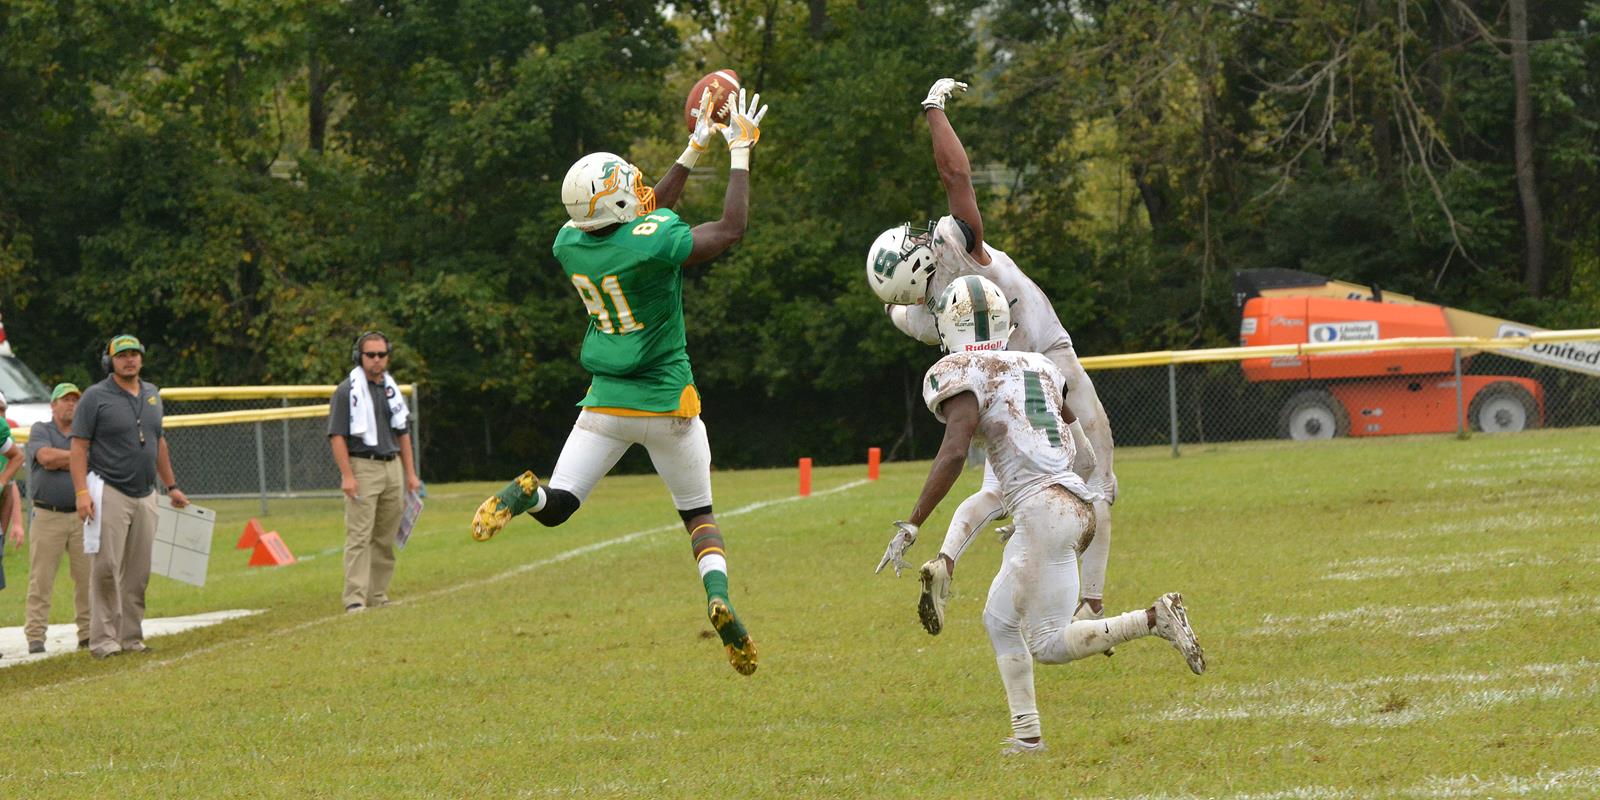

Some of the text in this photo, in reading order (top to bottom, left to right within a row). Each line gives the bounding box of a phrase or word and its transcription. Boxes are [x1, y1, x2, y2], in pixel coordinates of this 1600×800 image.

[1339, 324, 1372, 333] United
[965, 340, 1002, 351] Riddell
[1024, 370, 1062, 448] 4
